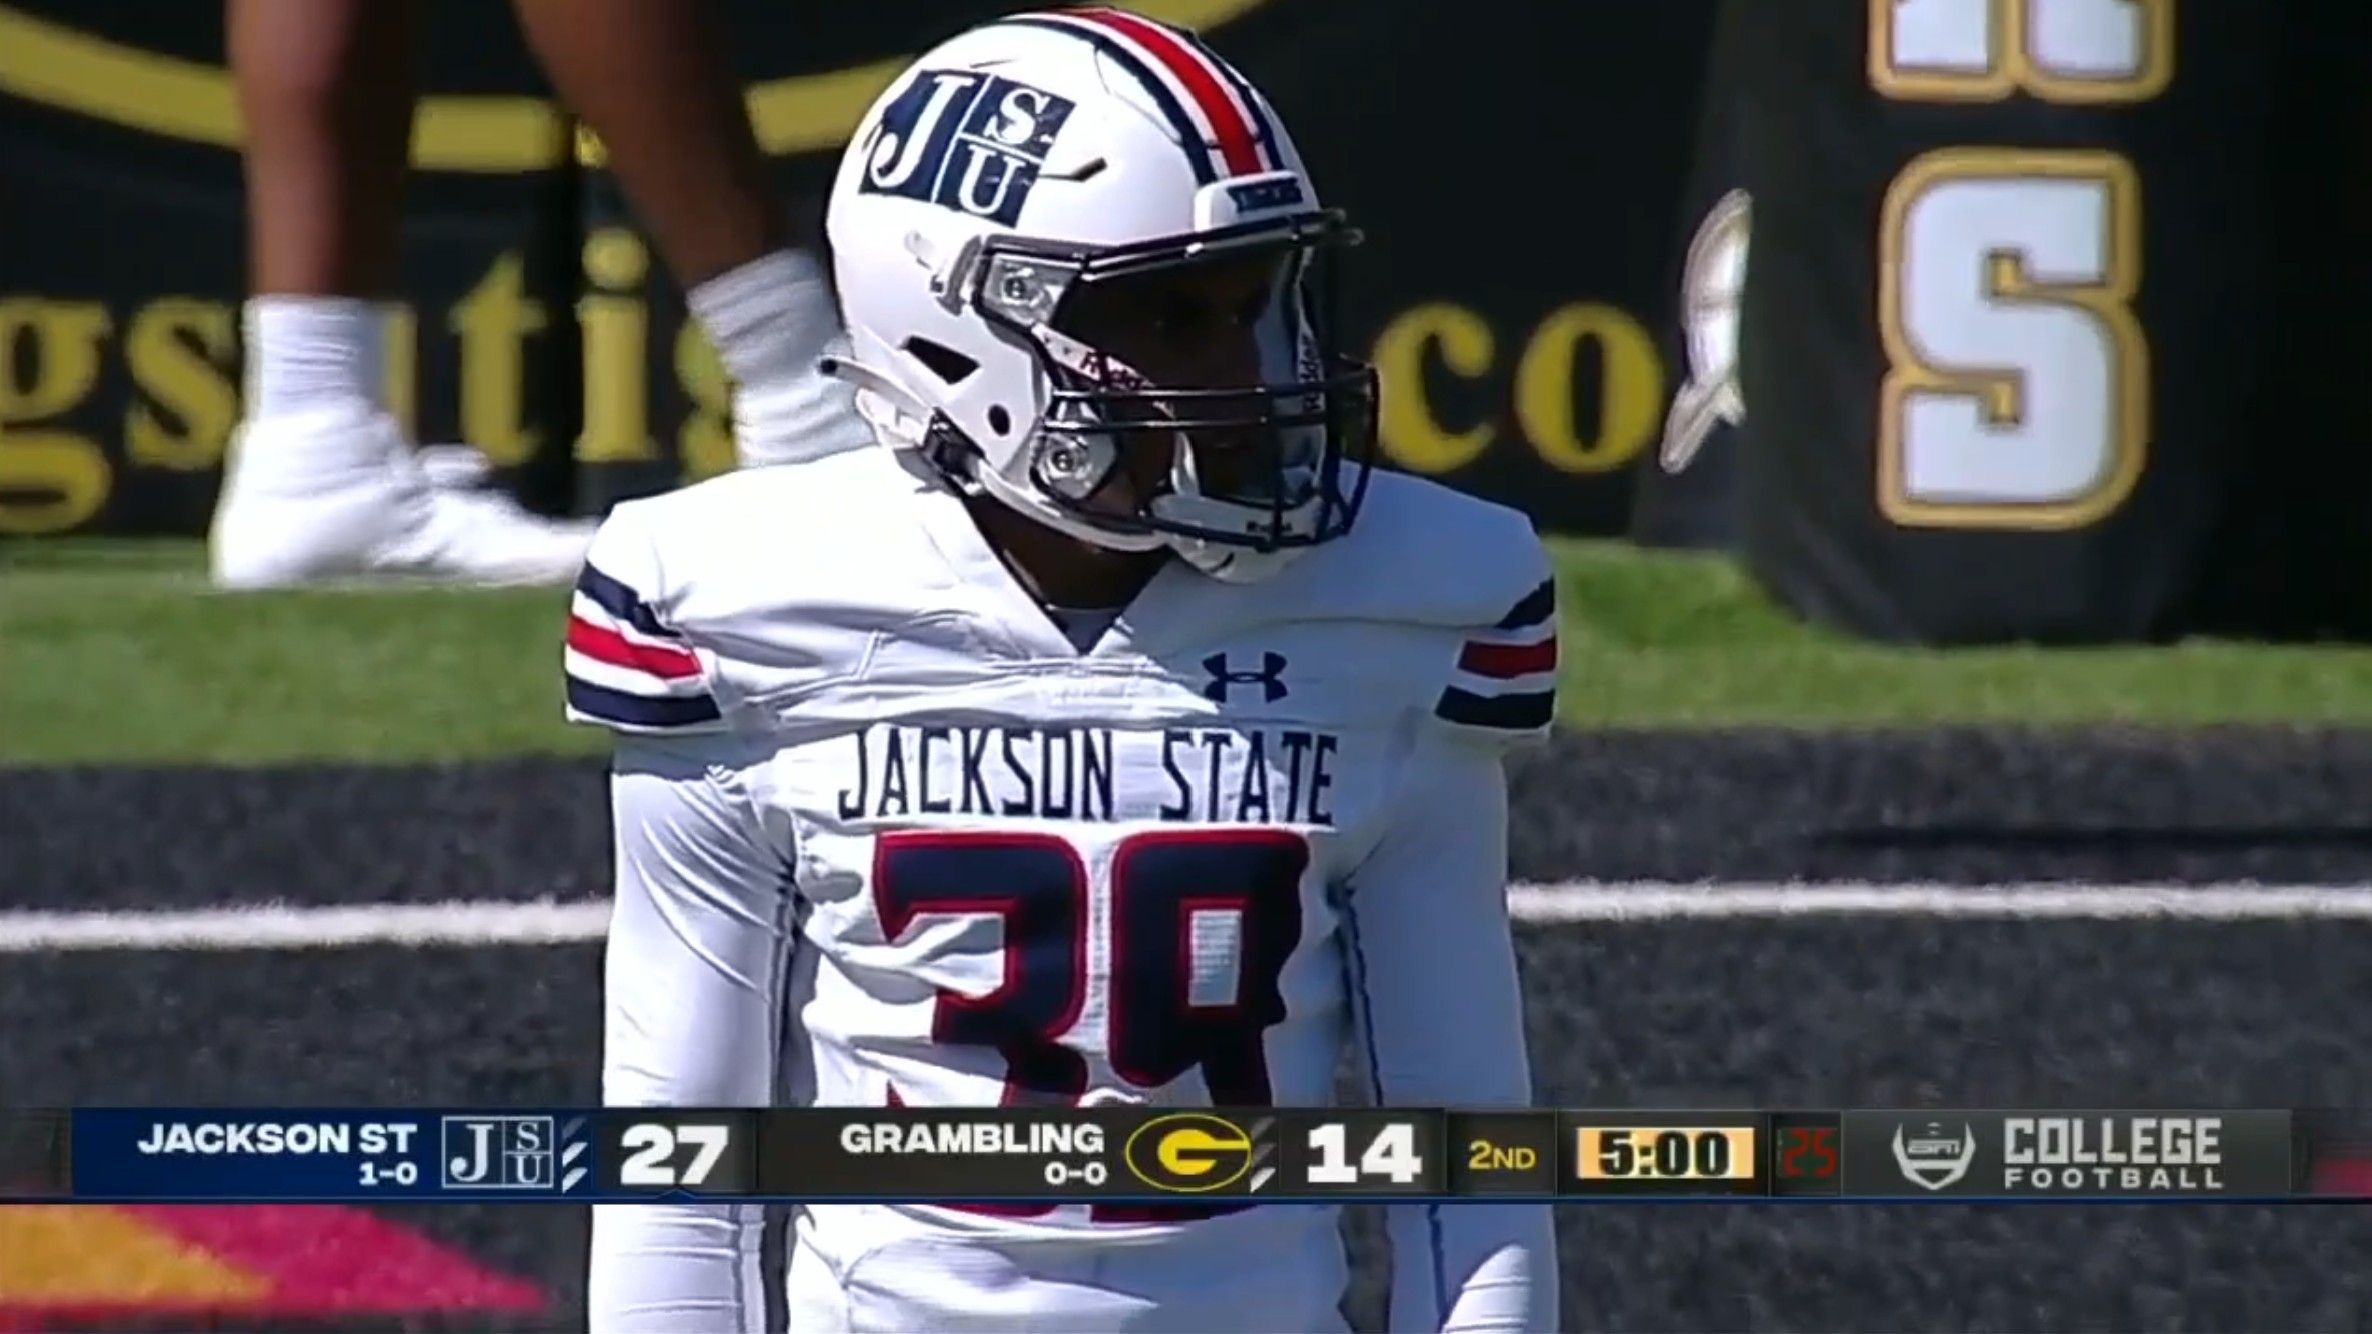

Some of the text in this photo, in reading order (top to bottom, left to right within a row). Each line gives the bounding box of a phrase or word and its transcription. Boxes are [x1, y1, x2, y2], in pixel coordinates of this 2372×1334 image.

[1868, 0, 2175, 530] S
[838, 727, 1338, 826] JACKSON STATE
